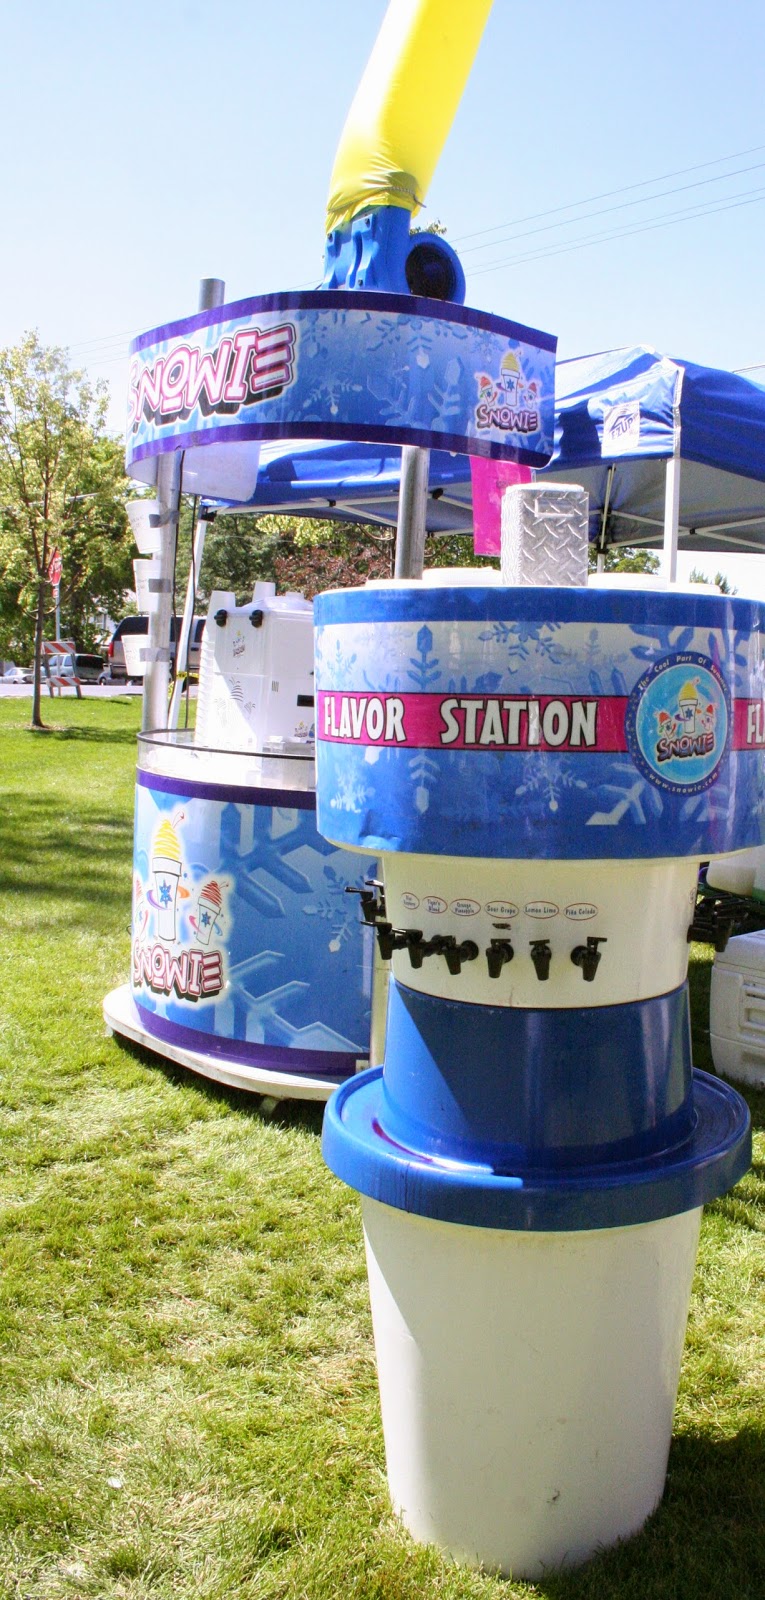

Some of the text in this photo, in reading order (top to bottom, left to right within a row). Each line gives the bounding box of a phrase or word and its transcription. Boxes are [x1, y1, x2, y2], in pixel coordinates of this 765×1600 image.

[128, 322, 296, 432] SNOWIE
[477, 405, 539, 432] SNOWIE
[637, 676, 650, 691] The
[654, 659, 670, 673] Cool
[676, 654, 692, 663] Part
[324, 696, 598, 747] FLAVOR STATION
[746, 703, 765, 744] FL
[657, 732, 714, 762] SNOWIE
[500, 906, 516, 915] Grape
[525, 906, 557, 914] Lemon Lime
[133, 939, 223, 1003] SNOWIE
